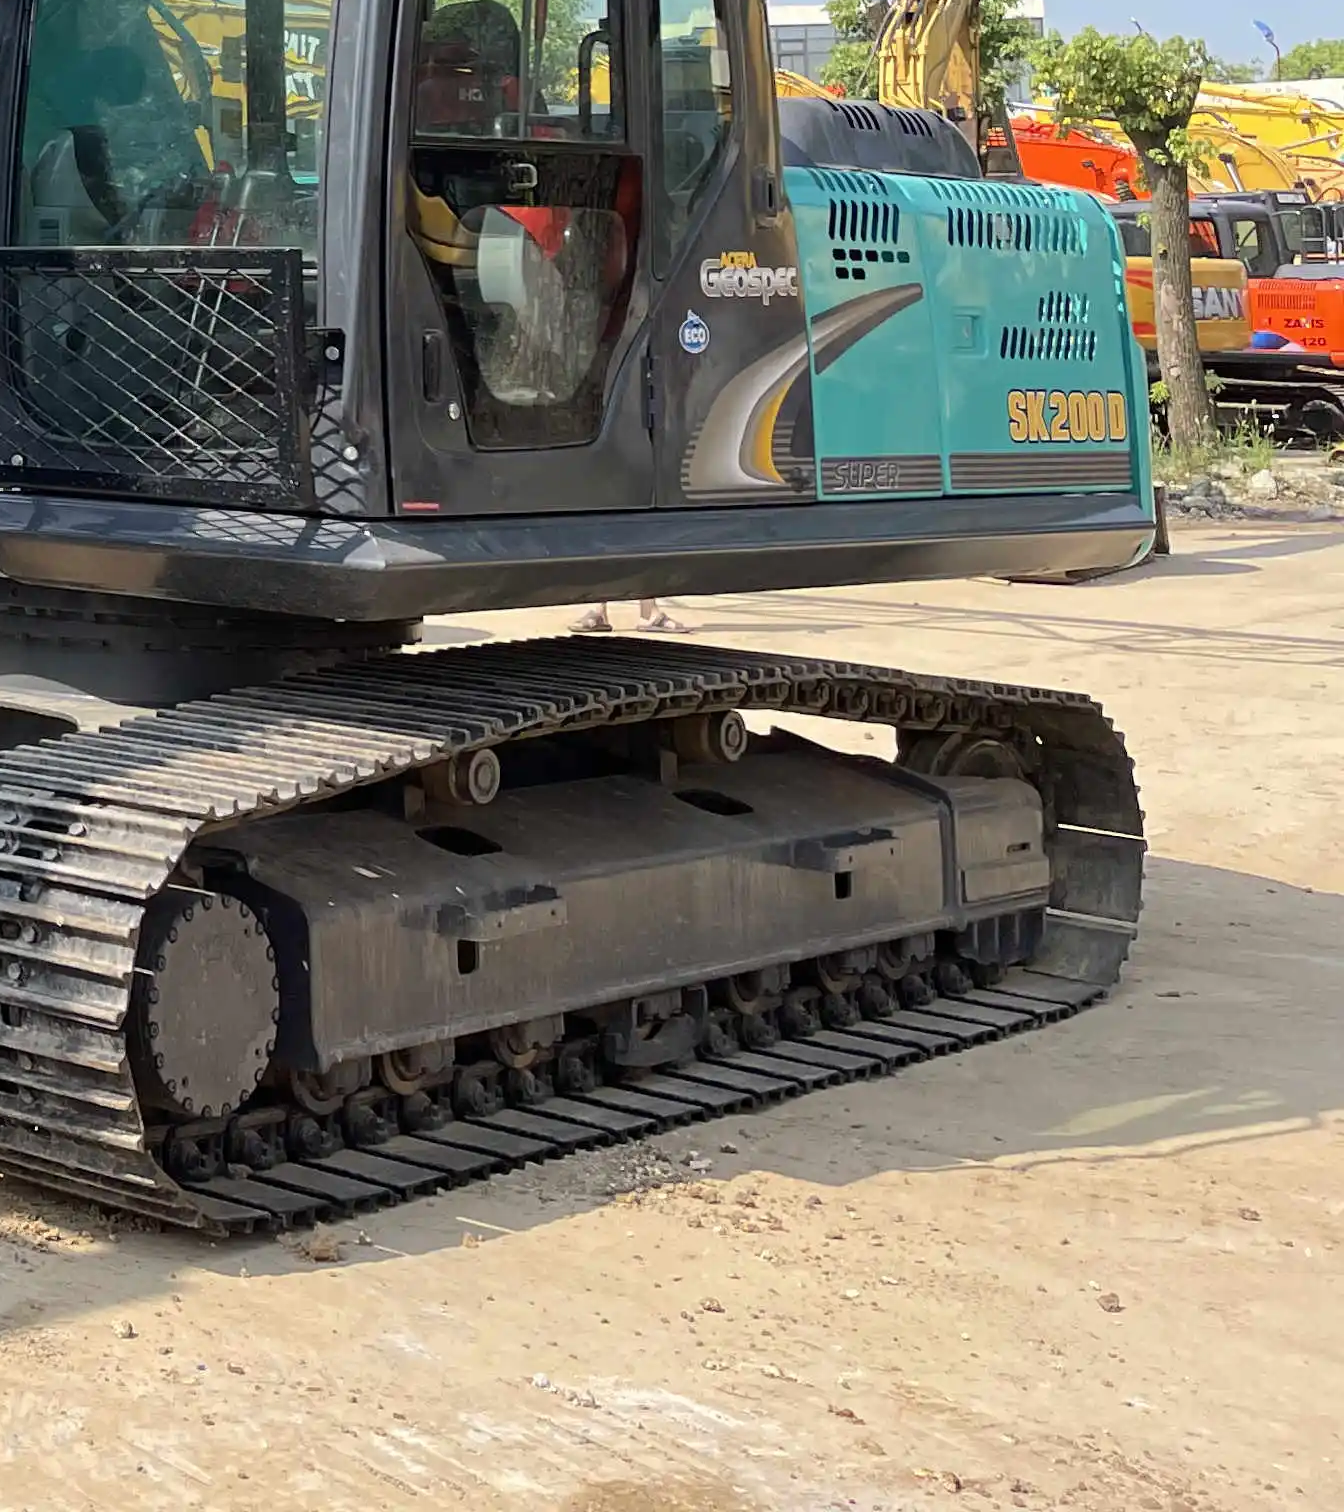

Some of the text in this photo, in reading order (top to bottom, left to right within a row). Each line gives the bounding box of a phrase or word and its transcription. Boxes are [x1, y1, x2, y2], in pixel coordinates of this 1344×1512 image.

[1192, 287, 1244, 319] SAN
[683, 328, 706, 344] ECO
[1302, 337, 1326, 347] 120
[832, 460, 901, 491] SUPER
